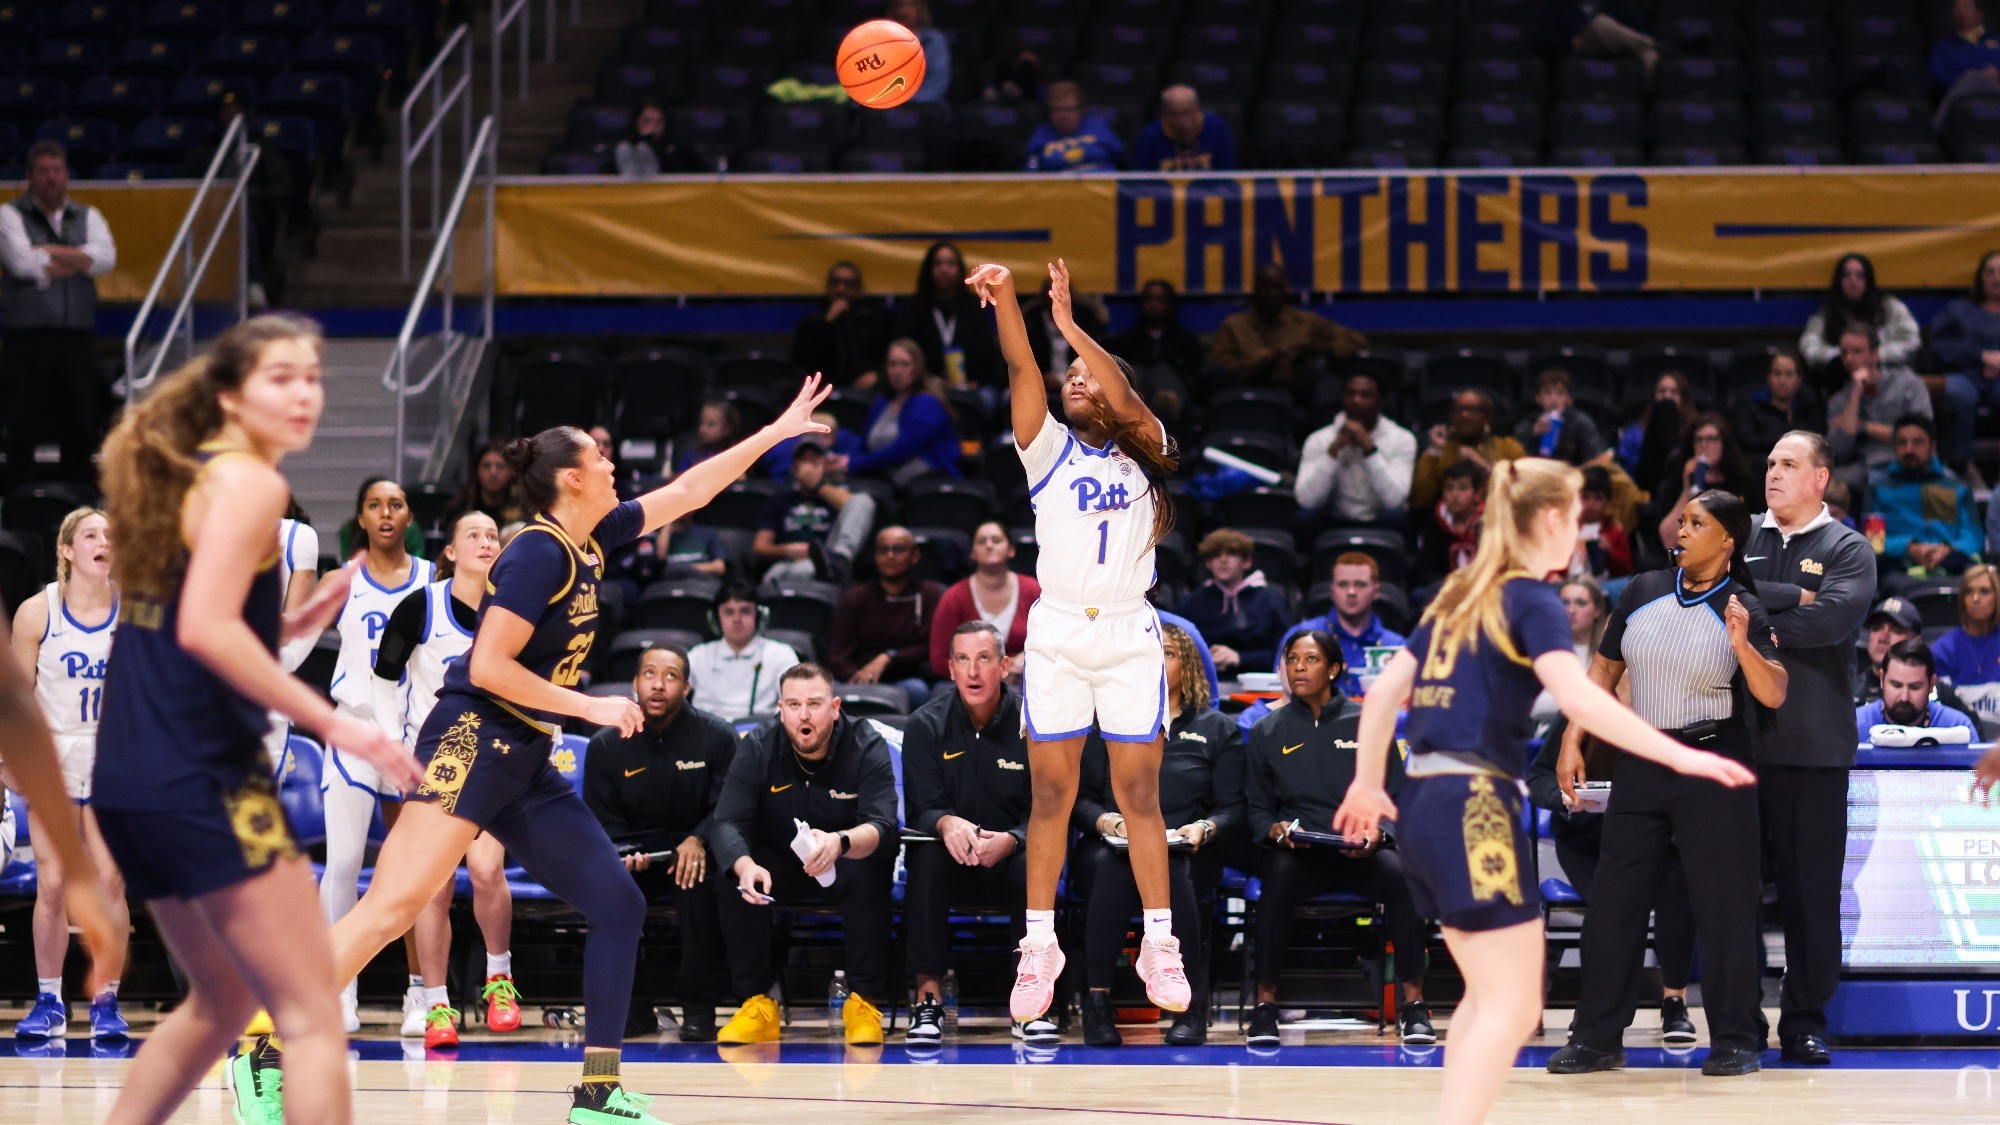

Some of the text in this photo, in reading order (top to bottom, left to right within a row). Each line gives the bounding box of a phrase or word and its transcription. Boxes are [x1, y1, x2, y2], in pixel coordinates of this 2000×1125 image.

[1116, 175, 1648, 293] PANTHERS
[1070, 477, 1131, 511] Pitt
[1098, 520, 1109, 565] 1
[551, 631, 595, 686] 22
[79, 687, 101, 722] 11
